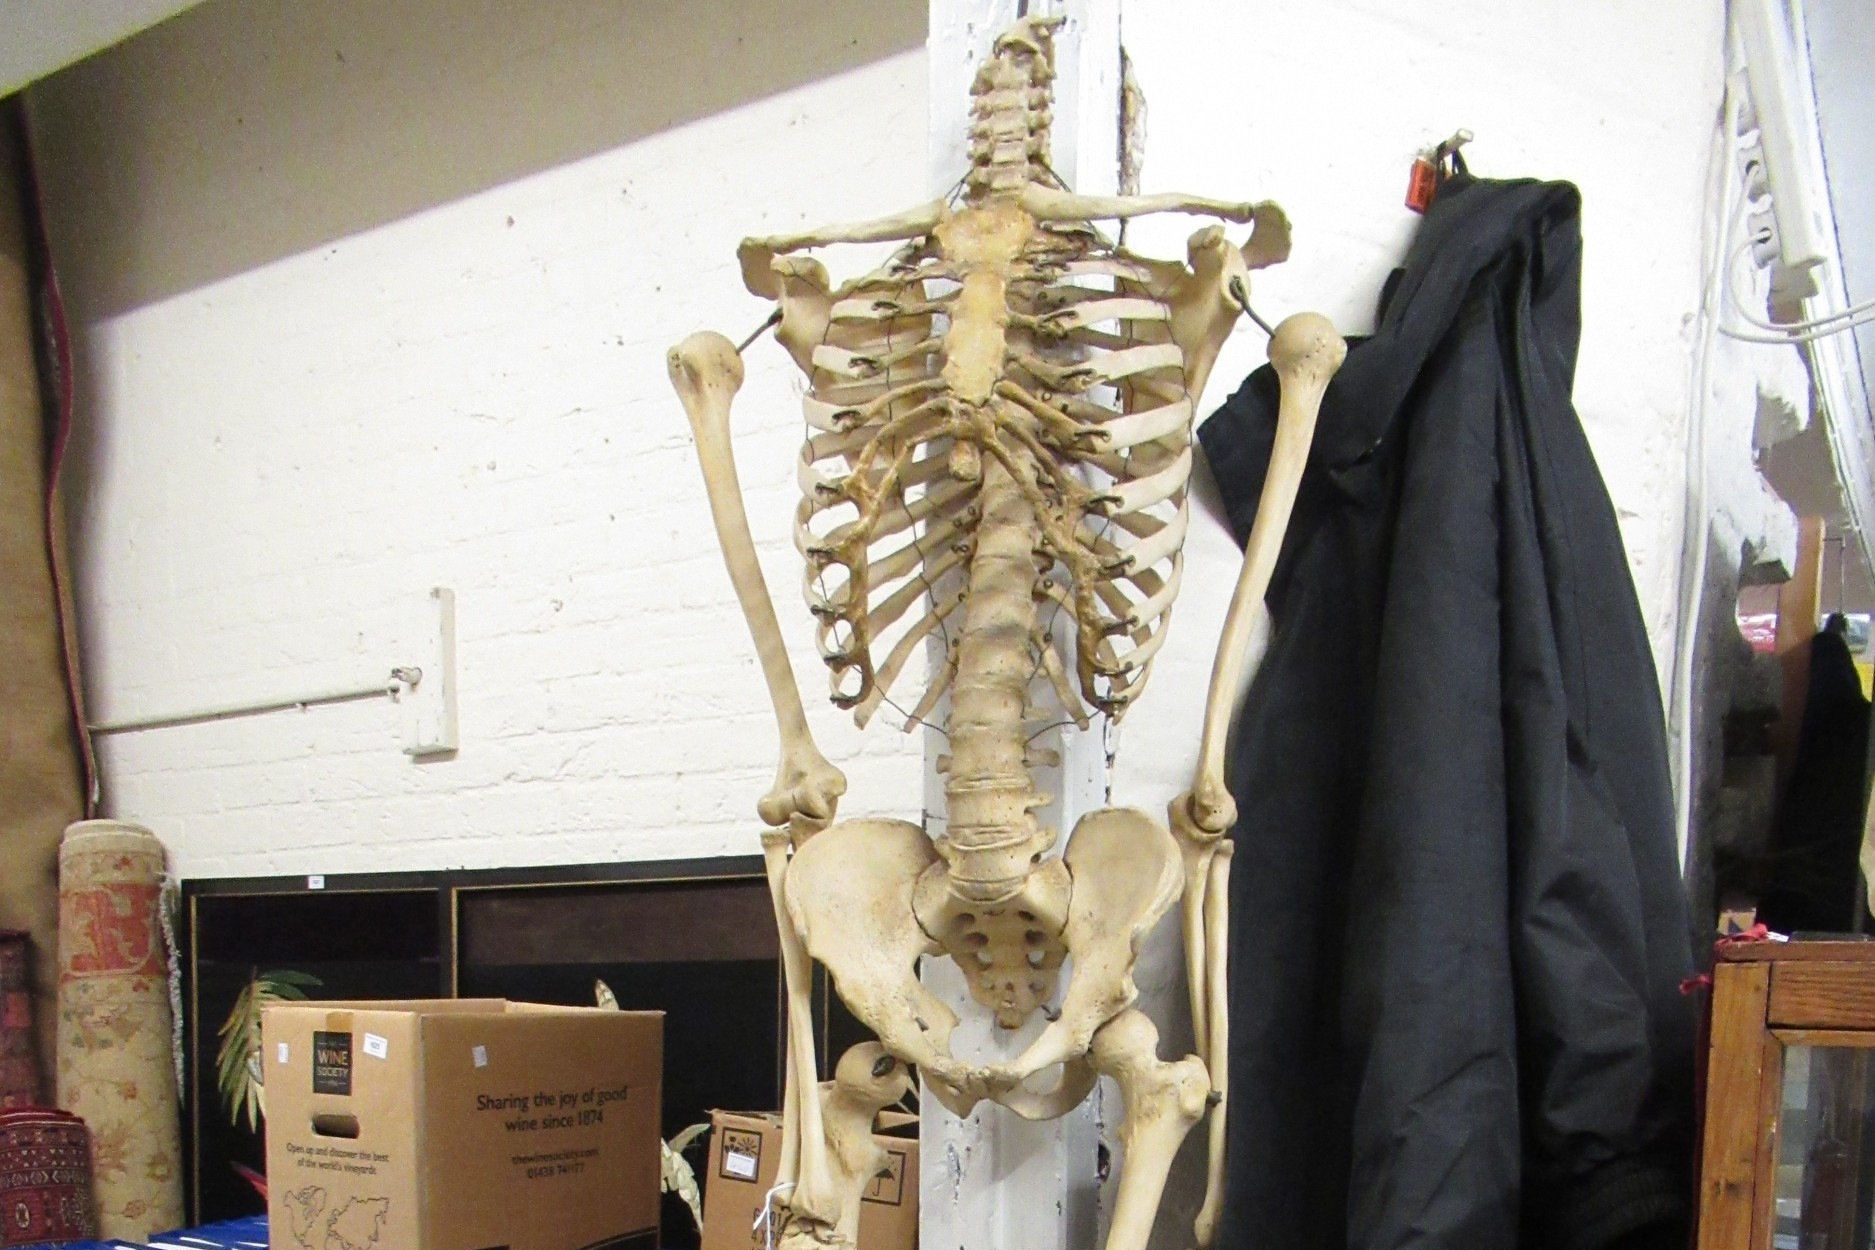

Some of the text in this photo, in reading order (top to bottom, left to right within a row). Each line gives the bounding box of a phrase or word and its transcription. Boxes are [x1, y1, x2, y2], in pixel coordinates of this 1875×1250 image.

[317, 1049, 349, 1066] WINE
[317, 1066, 349, 1078] SOCIETY
[476, 1086, 628, 1112] Sharing the joy of good
[505, 1110, 603, 1131] wine since 1874
[286, 1142, 389, 1162] Open up and discover the best
[511, 1148, 599, 1164] thewinesociety.com
[298, 1158, 305, 1167] of
[306, 1159, 316, 1168] the
[344, 1164, 377, 1175] vineyards
[527, 1166, 554, 1178] 01438
